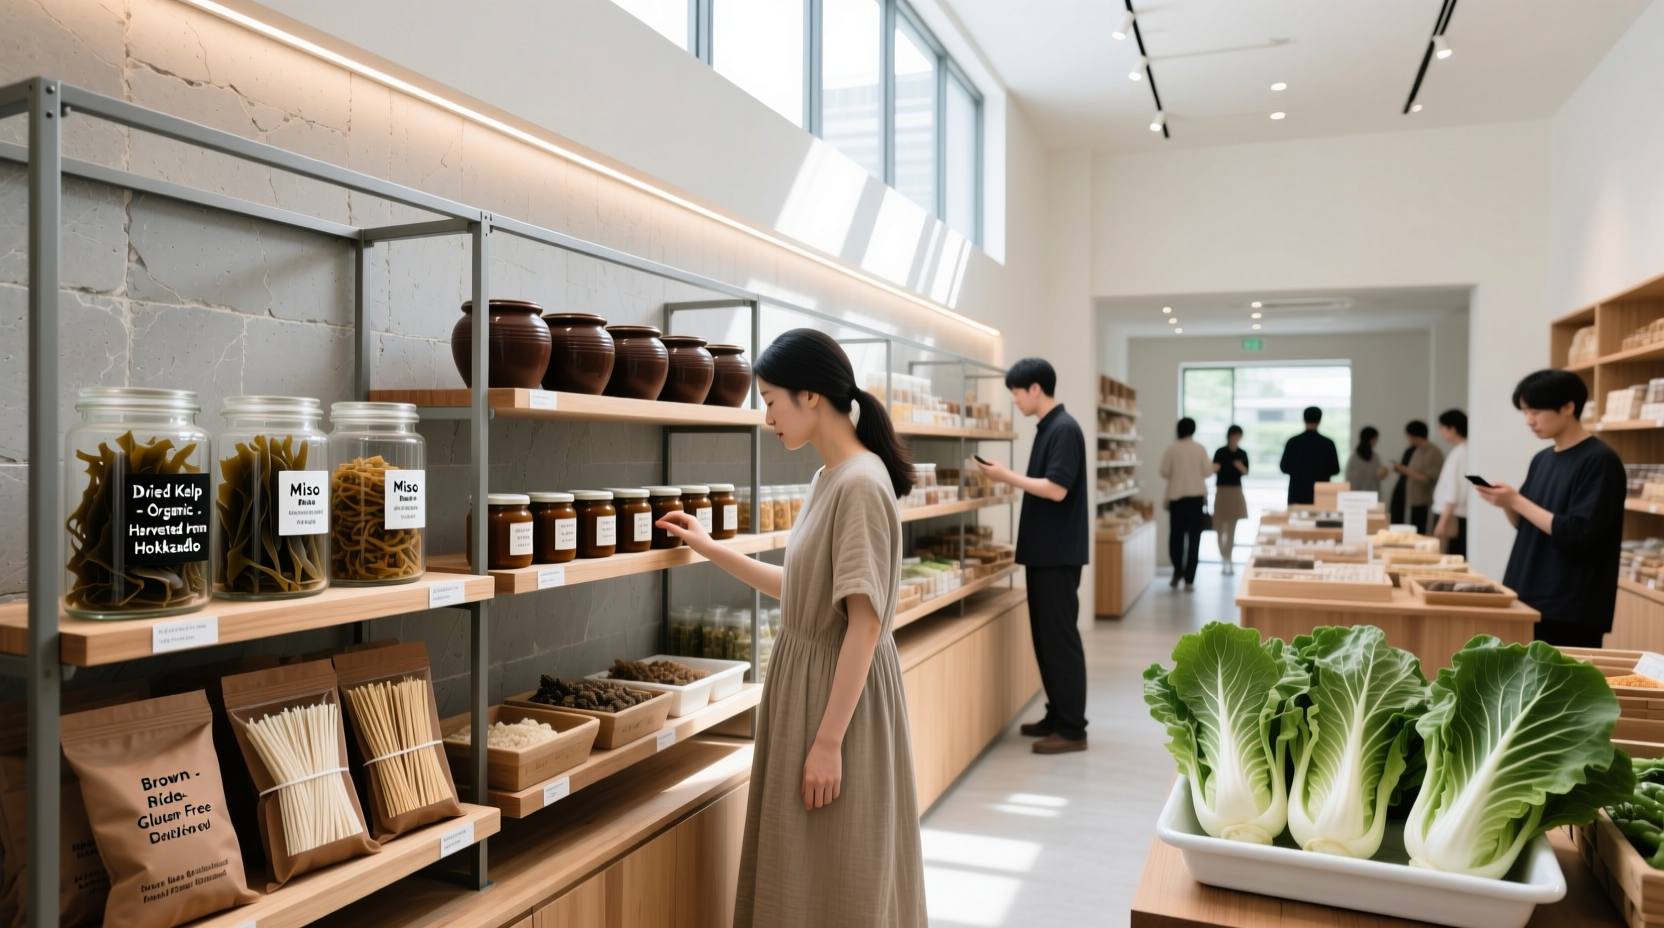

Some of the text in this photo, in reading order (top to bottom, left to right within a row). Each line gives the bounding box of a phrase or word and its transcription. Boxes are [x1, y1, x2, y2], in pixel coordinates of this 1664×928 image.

[132, 483, 203, 501] Dried Kelp
[290, 482, 320, 497] Miso
[393, 480, 419, 493] Miso
[140, 770, 190, 791] Brown
[184, 804, 212, 817] Free
